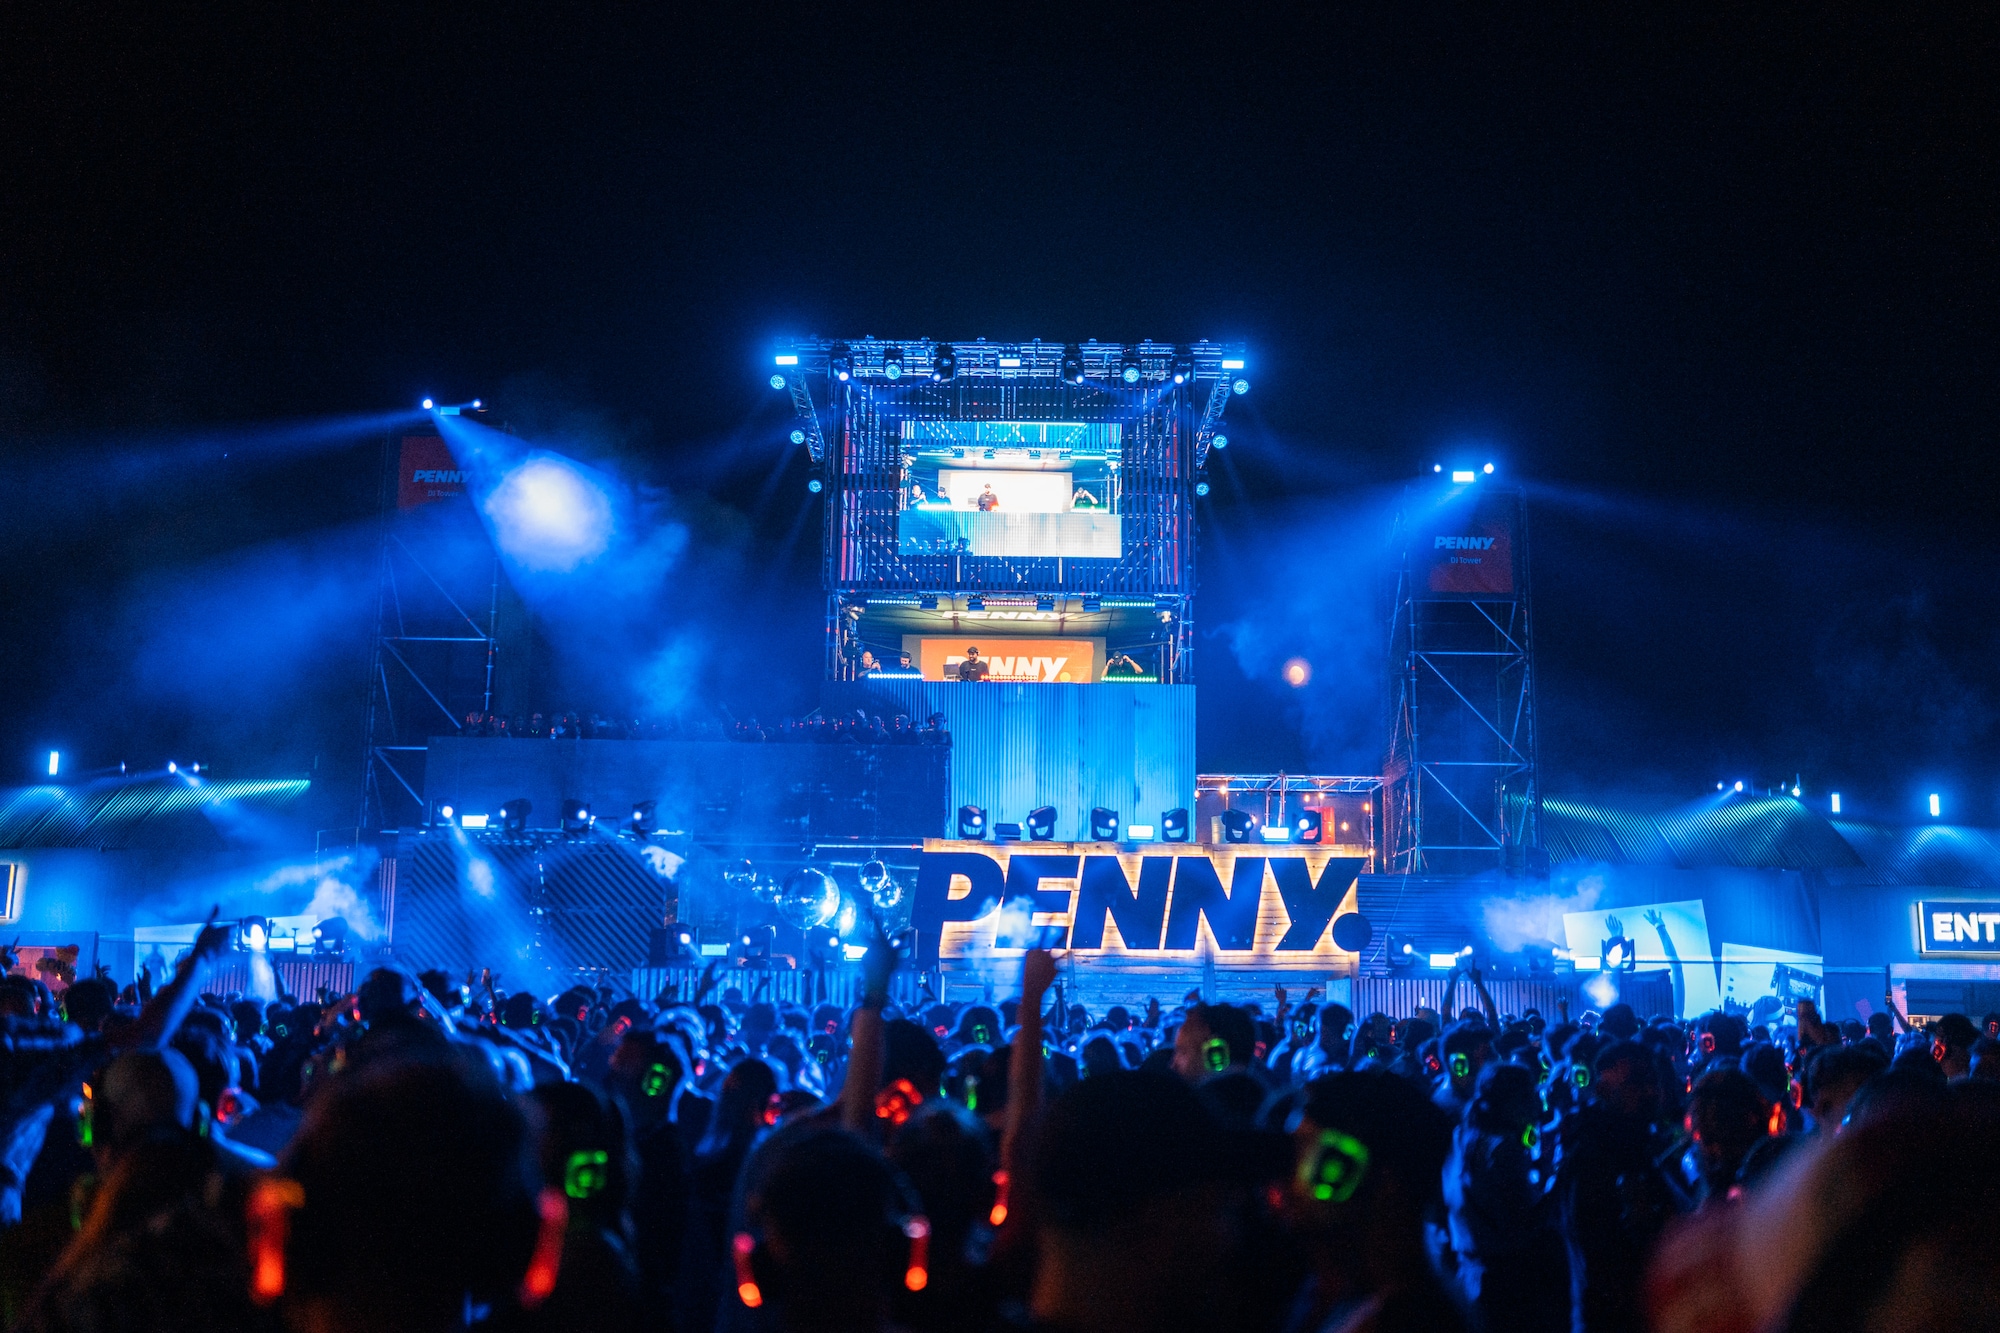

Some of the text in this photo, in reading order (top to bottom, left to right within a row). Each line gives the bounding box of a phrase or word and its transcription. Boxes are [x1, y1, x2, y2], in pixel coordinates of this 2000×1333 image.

[413, 469, 475, 483] PENNY
[945, 656, 1071, 682] NNY.
[1932, 912, 2000, 943] ENT
